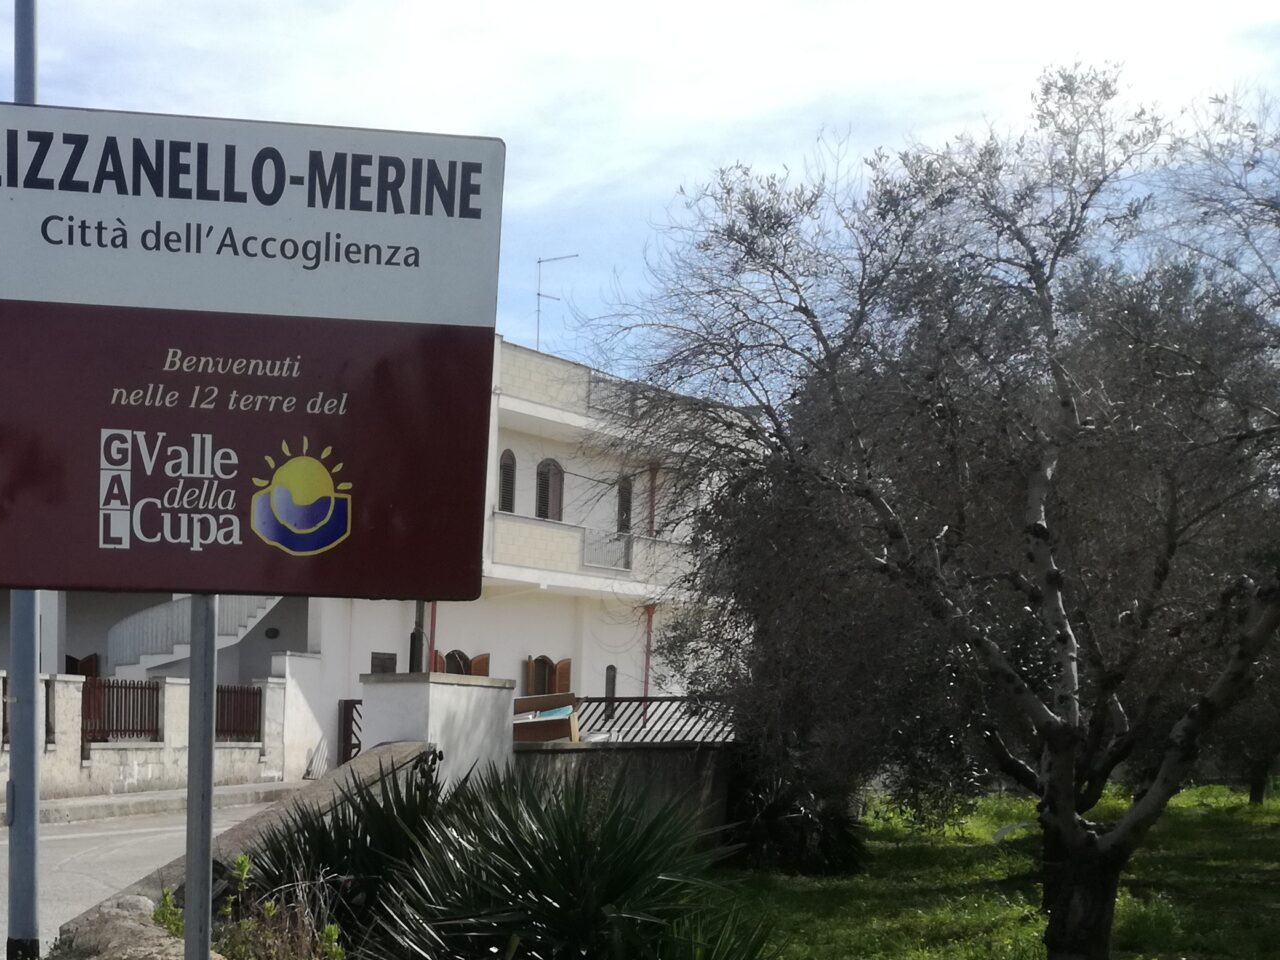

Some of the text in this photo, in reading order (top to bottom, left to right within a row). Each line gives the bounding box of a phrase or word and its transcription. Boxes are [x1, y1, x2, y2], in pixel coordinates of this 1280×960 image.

[41, 214, 420, 271] Città dell'Accoglienza
[163, 348, 302, 378] Benvenuti
[111, 384, 348, 415] nelle 12 terre del
[133, 431, 239, 479] Valle
[163, 479, 237, 511] della
[132, 497, 243, 551] Cupa
